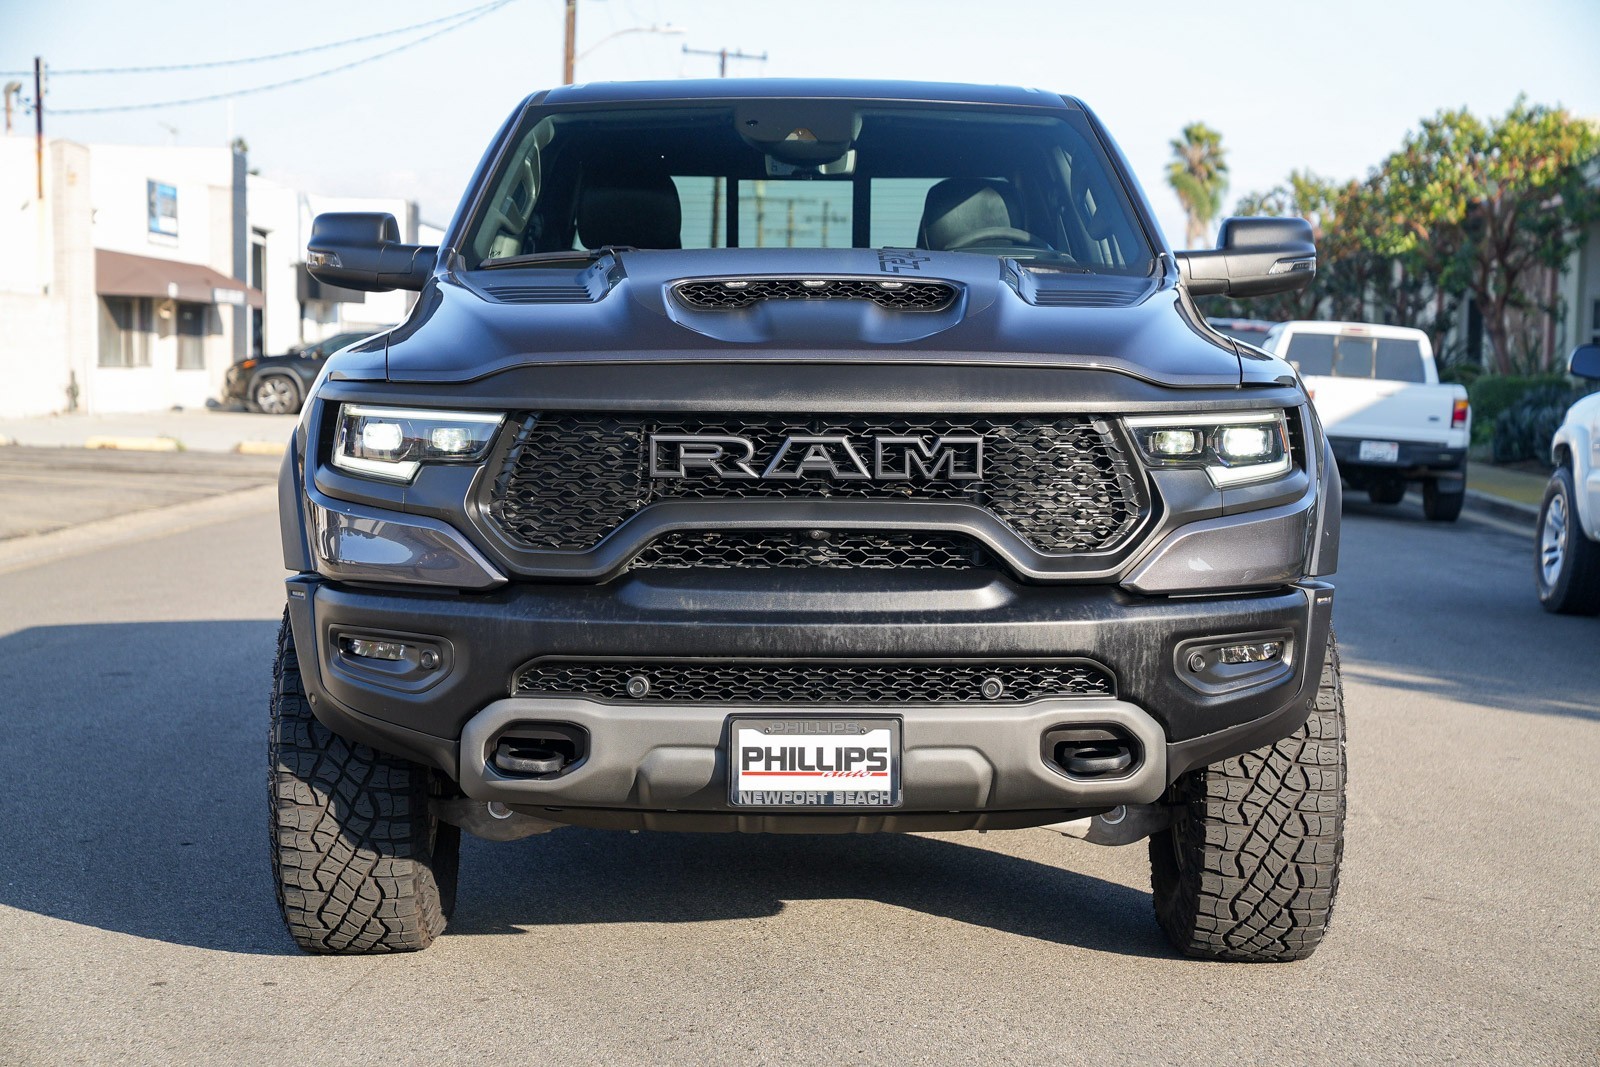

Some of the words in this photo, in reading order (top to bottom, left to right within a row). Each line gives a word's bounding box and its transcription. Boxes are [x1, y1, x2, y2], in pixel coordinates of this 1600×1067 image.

[650, 434, 984, 479] RAM
[771, 721, 860, 734] PHILLIPS
[742, 747, 888, 771] PHILLIPS
[823, 770, 871, 778] auto
[739, 791, 828, 804] NEWPORT
[833, 791, 891, 804] BEACH
